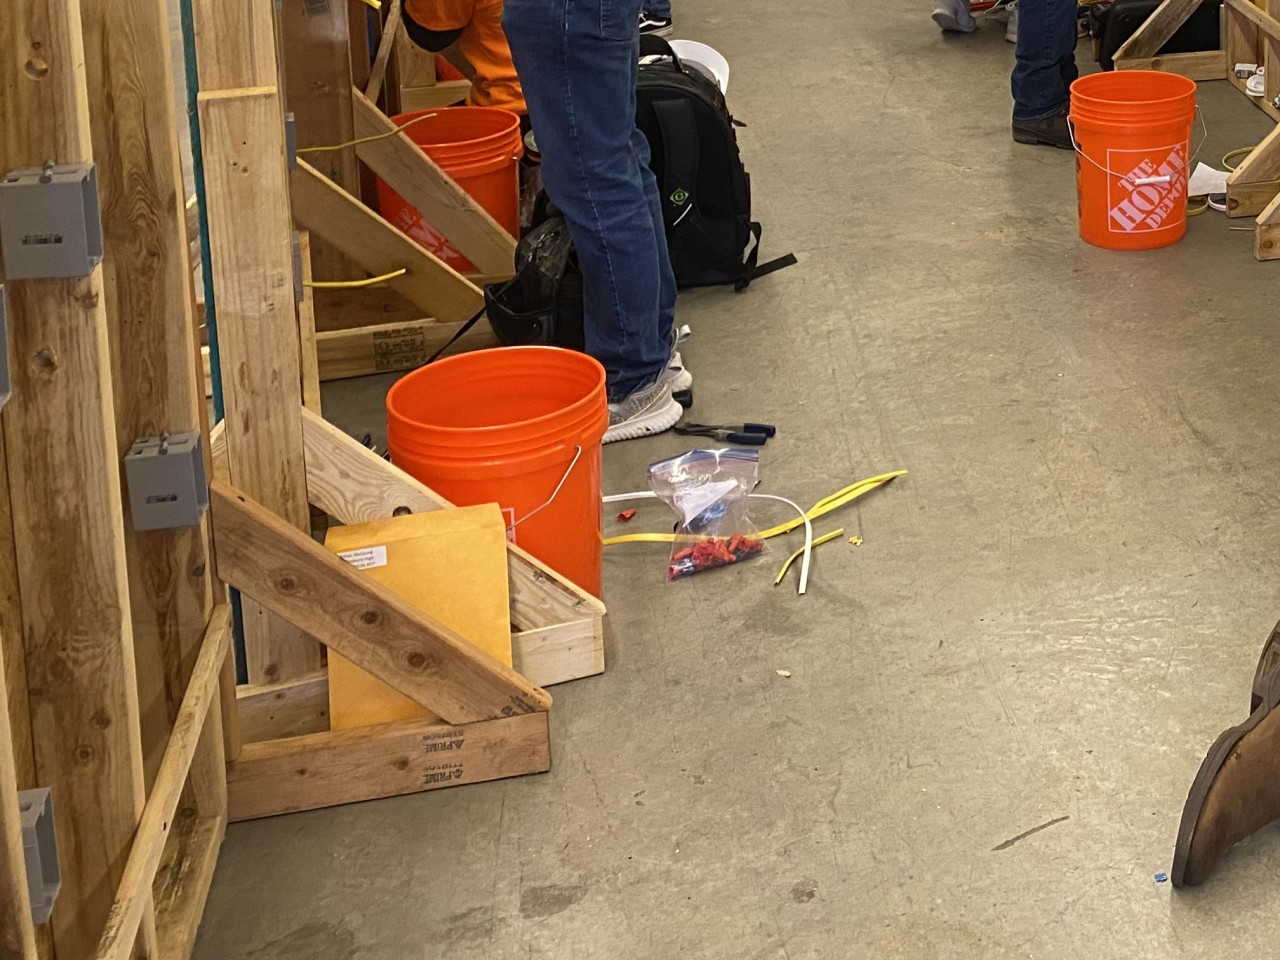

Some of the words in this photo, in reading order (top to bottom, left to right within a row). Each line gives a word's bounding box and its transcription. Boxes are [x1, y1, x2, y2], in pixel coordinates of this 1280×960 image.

[1117, 158, 1157, 192] THE
[1109, 143, 1185, 232] HOME
[423, 740, 453, 754] PRIME
[423, 769, 452, 784] PRIME
